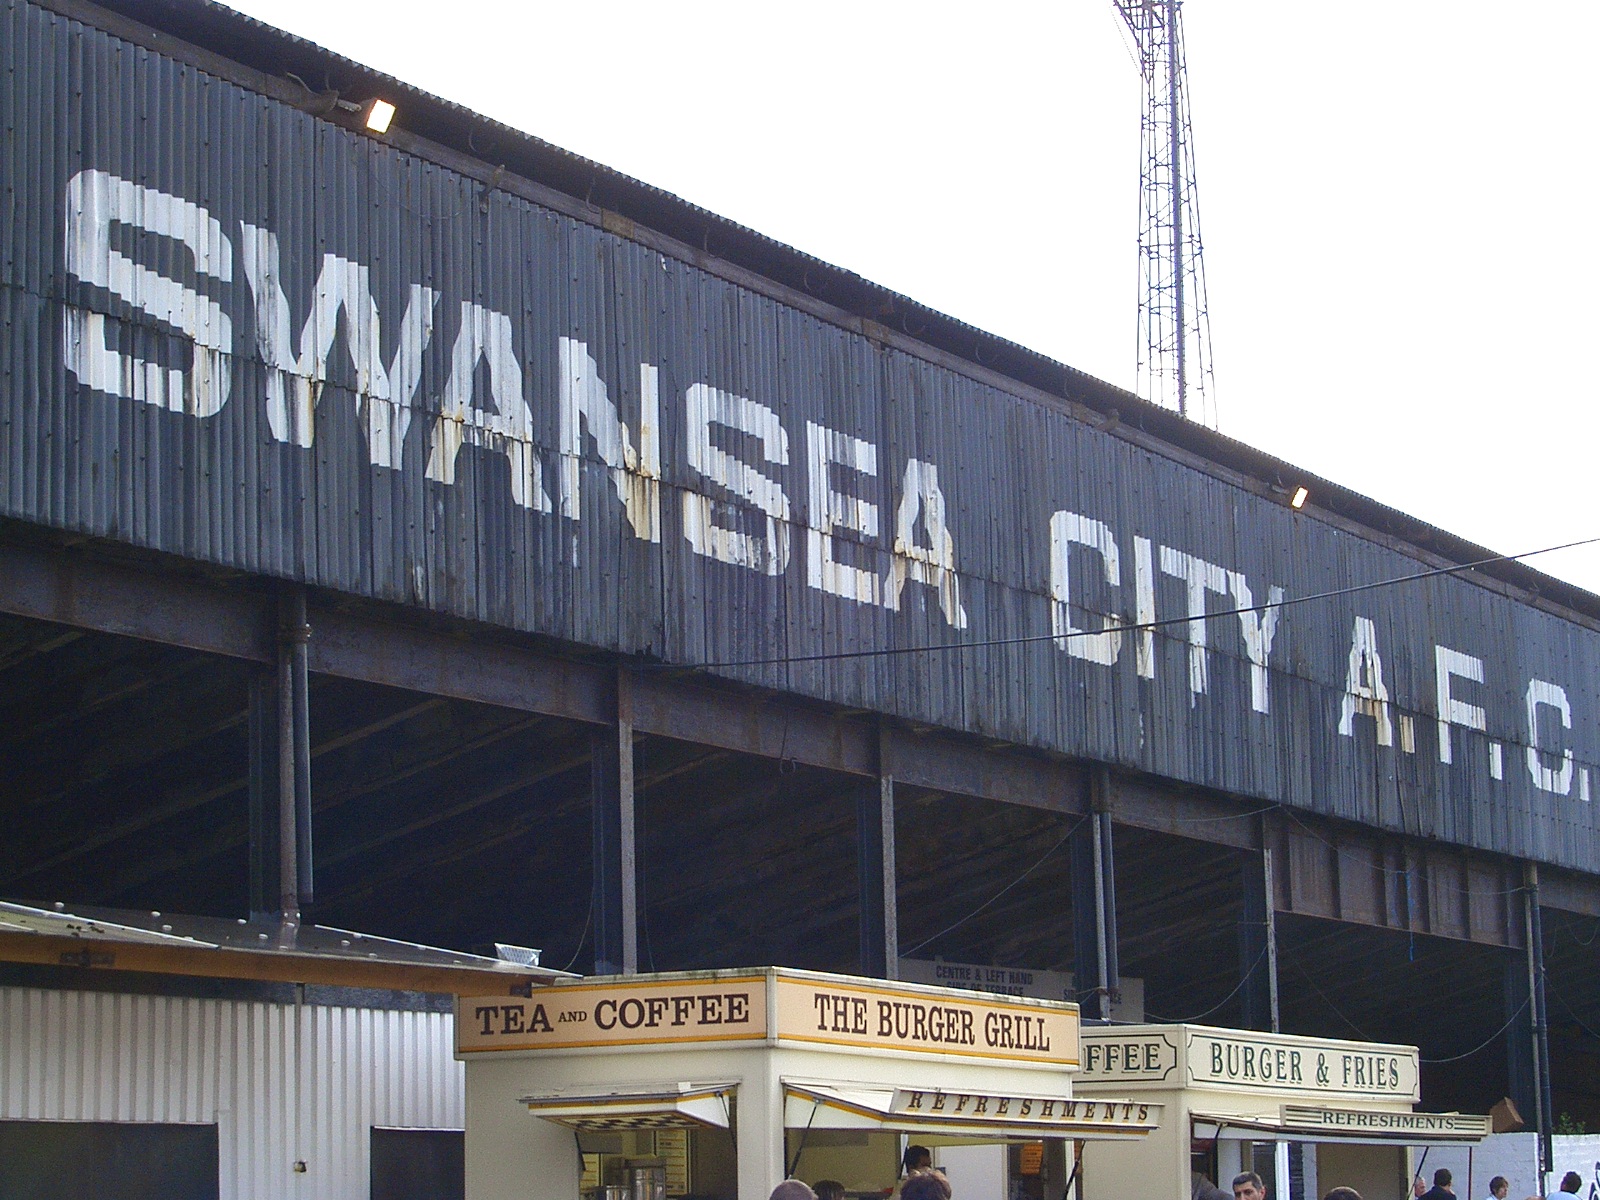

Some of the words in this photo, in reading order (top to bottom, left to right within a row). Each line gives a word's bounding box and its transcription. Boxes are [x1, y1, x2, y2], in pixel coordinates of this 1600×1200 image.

[63, 168, 967, 630] SWANSEA
[1050, 510, 1284, 714] CITY
[936, 965, 971, 981] CENTRE
[975, 969, 982, 981] &
[986, 969, 1006, 983] LEFT
[1009, 972, 1034, 985] HAND
[475, 1003, 554, 1036] TEA
[558, 1010, 588, 1023] AND
[594, 993, 749, 1030] COFFEE
[814, 993, 867, 1035] THE
[877, 1000, 975, 1046] BURGER
[984, 1011, 1050, 1052] GRILL
[1083, 1043, 1161, 1074] FFEE
[1210, 1042, 1303, 1083] BURGER
[1316, 1052, 1330, 1086] &
[1342, 1054, 1399, 1089] FRIES
[907, 1090, 1149, 1123] REFRESHMENTS
[1322, 1111, 1455, 1130] REFRESHMENTS
